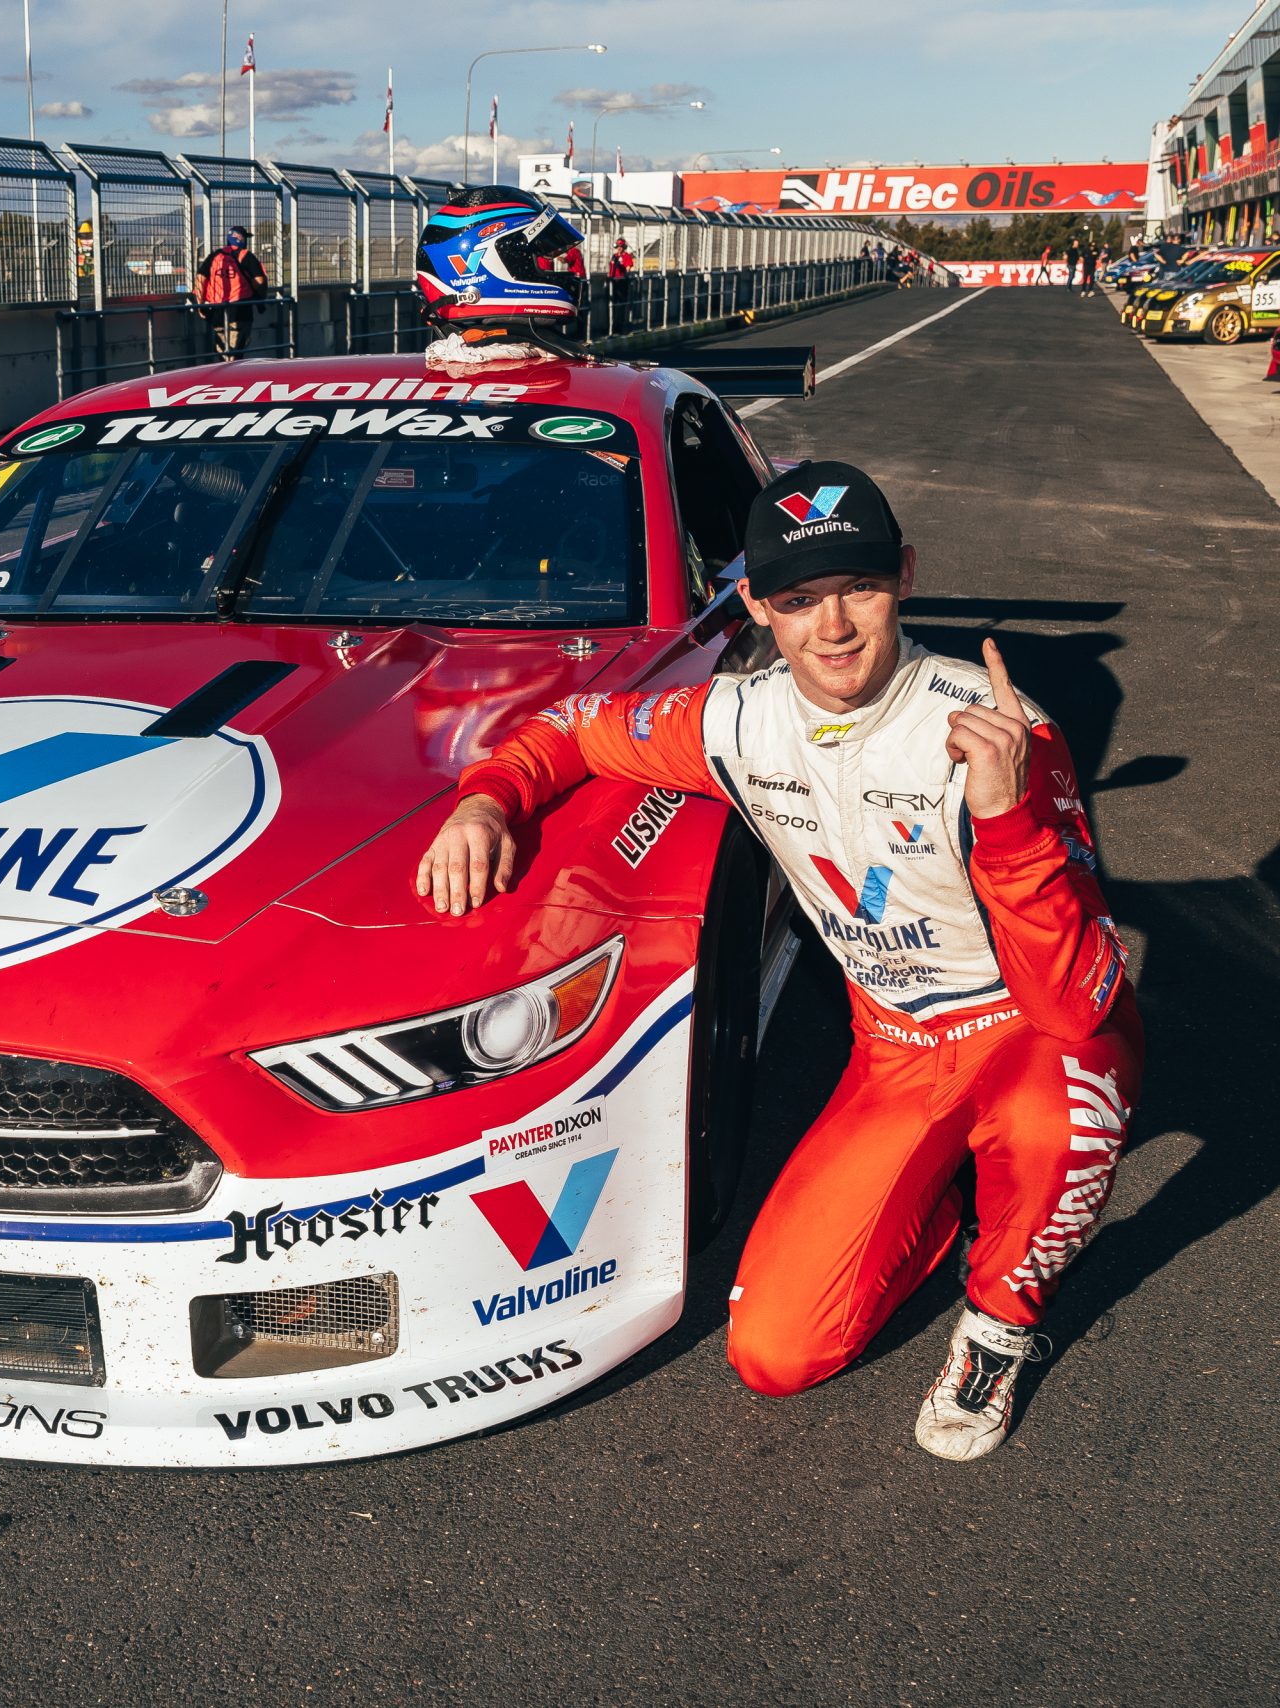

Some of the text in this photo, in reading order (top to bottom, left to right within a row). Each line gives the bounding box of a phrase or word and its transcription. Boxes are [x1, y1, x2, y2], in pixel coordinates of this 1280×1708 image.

[824, 170, 1056, 211] Hi-Tec Oils
[450, 275, 488, 287] Valvoline
[943, 264, 995, 284] RF
[149, 378, 527, 409] Valvoline
[97, 408, 513, 445] TurtleWax
[782, 520, 853, 544] Valvoline
[747, 773, 811, 797] Trans Am
[862, 789, 946, 811] GRM
[611, 786, 686, 870] LISMO
[750, 803, 819, 832] S5000
[888, 841, 937, 855] VALVOLINE
[488, 1106, 602, 1157] PAYNTER DIXON
[514, 1133, 583, 1161] CREATING SINCE 1914
[216, 1187, 441, 1265] Hoosier
[472, 1257, 619, 1327] Valvoline
[214, 1338, 584, 1441] VOLVO TRUCKS
